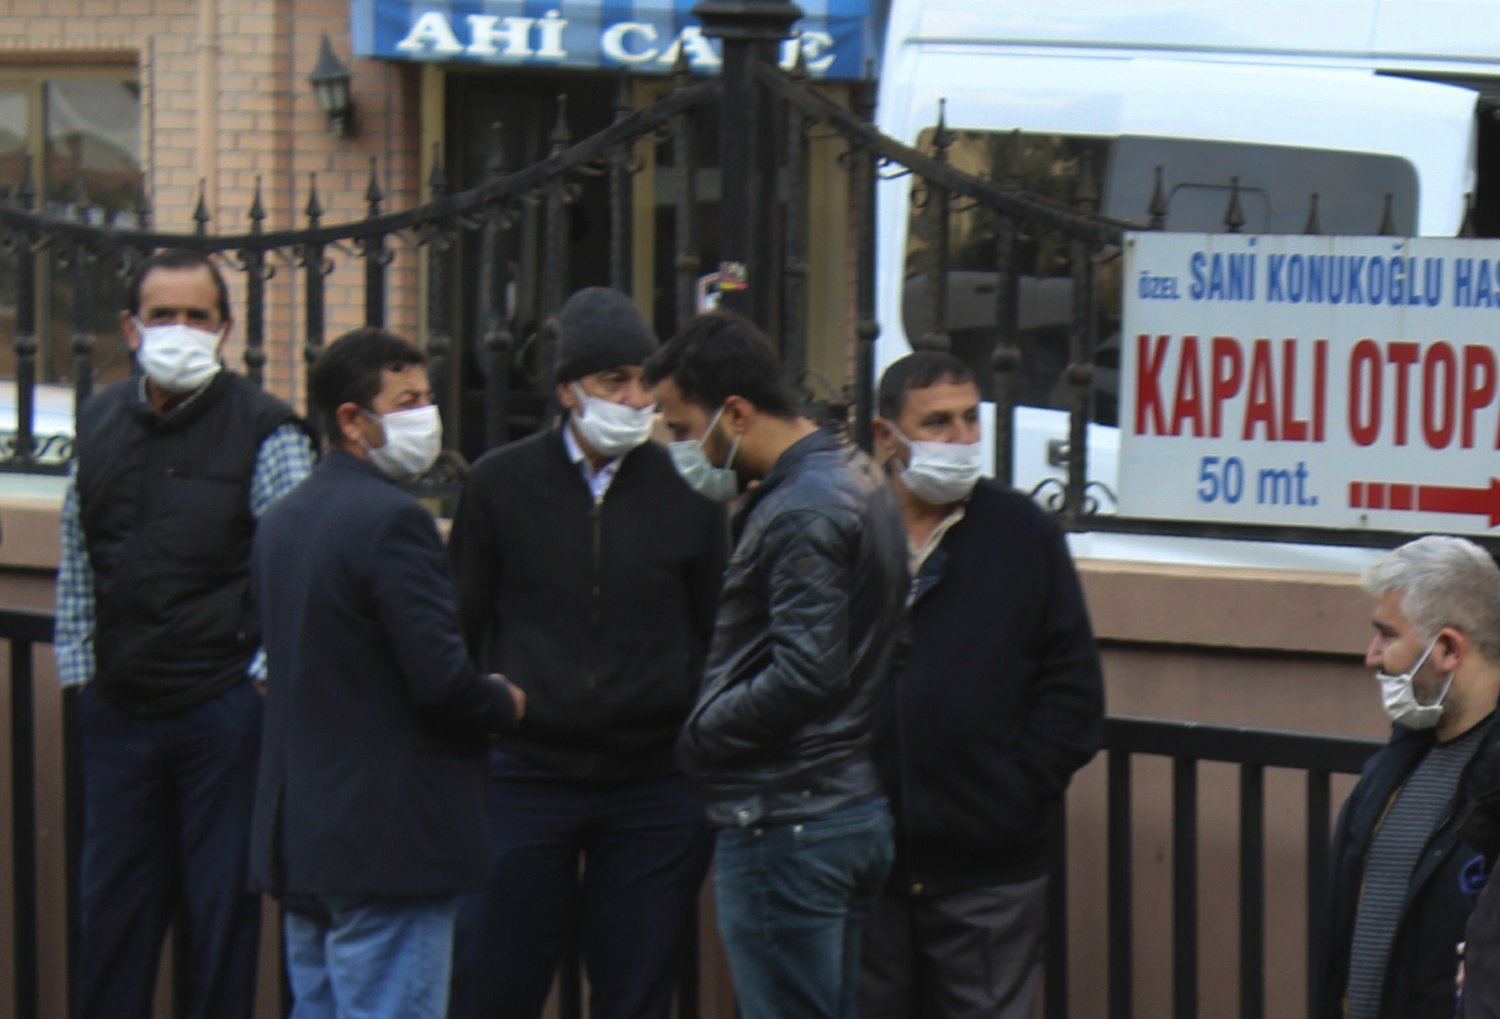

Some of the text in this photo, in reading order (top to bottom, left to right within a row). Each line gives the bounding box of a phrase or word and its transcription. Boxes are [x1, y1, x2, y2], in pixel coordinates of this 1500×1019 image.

[396, 11, 836, 73] AHİ CAE
[1189, 238, 1258, 302] SANİ
[1265, 245, 1443, 308] KONUKOĞLU
[1134, 334, 1329, 442] KAPALI
[1198, 456, 1319, 508] 50 mt.
